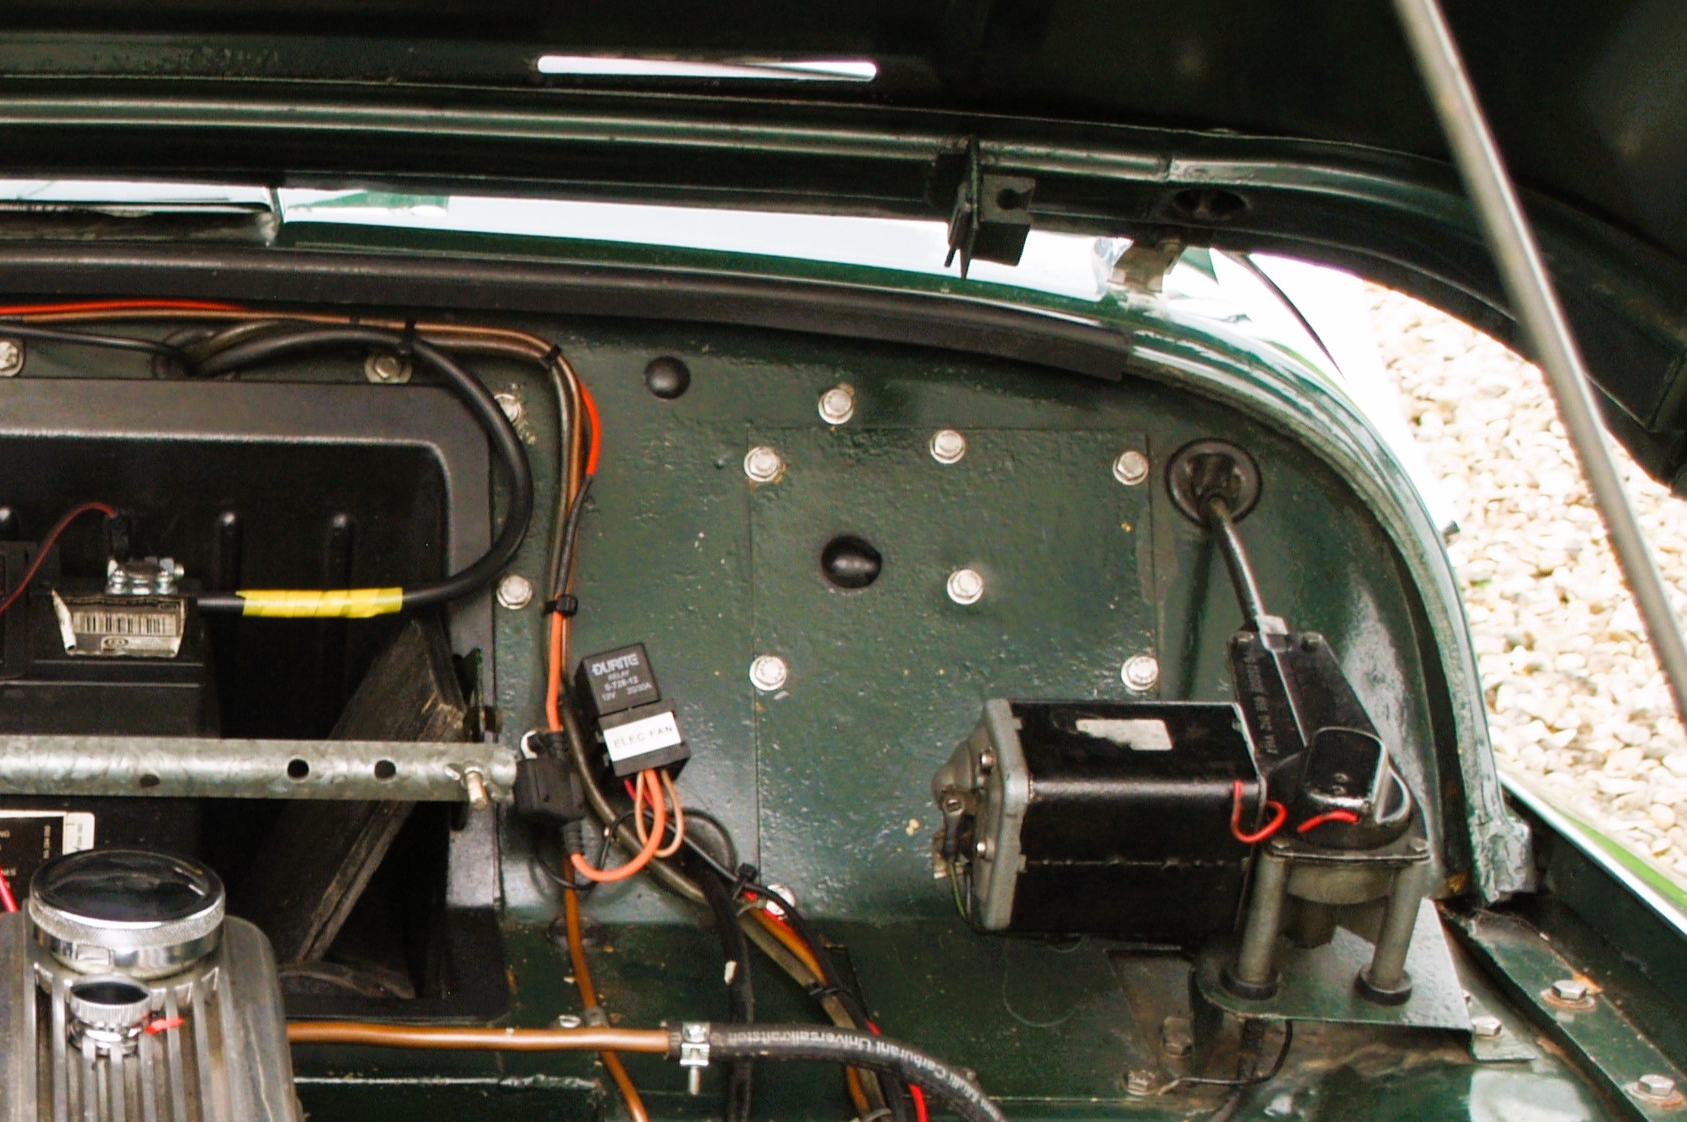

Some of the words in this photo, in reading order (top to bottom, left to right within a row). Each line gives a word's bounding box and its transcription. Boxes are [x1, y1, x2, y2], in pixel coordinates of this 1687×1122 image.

[591, 652, 640, 676] DURITE
[613, 732, 646, 748] ELEC
[649, 725, 673, 736] FAN
[869, 1040, 947, 1080] Carburant
